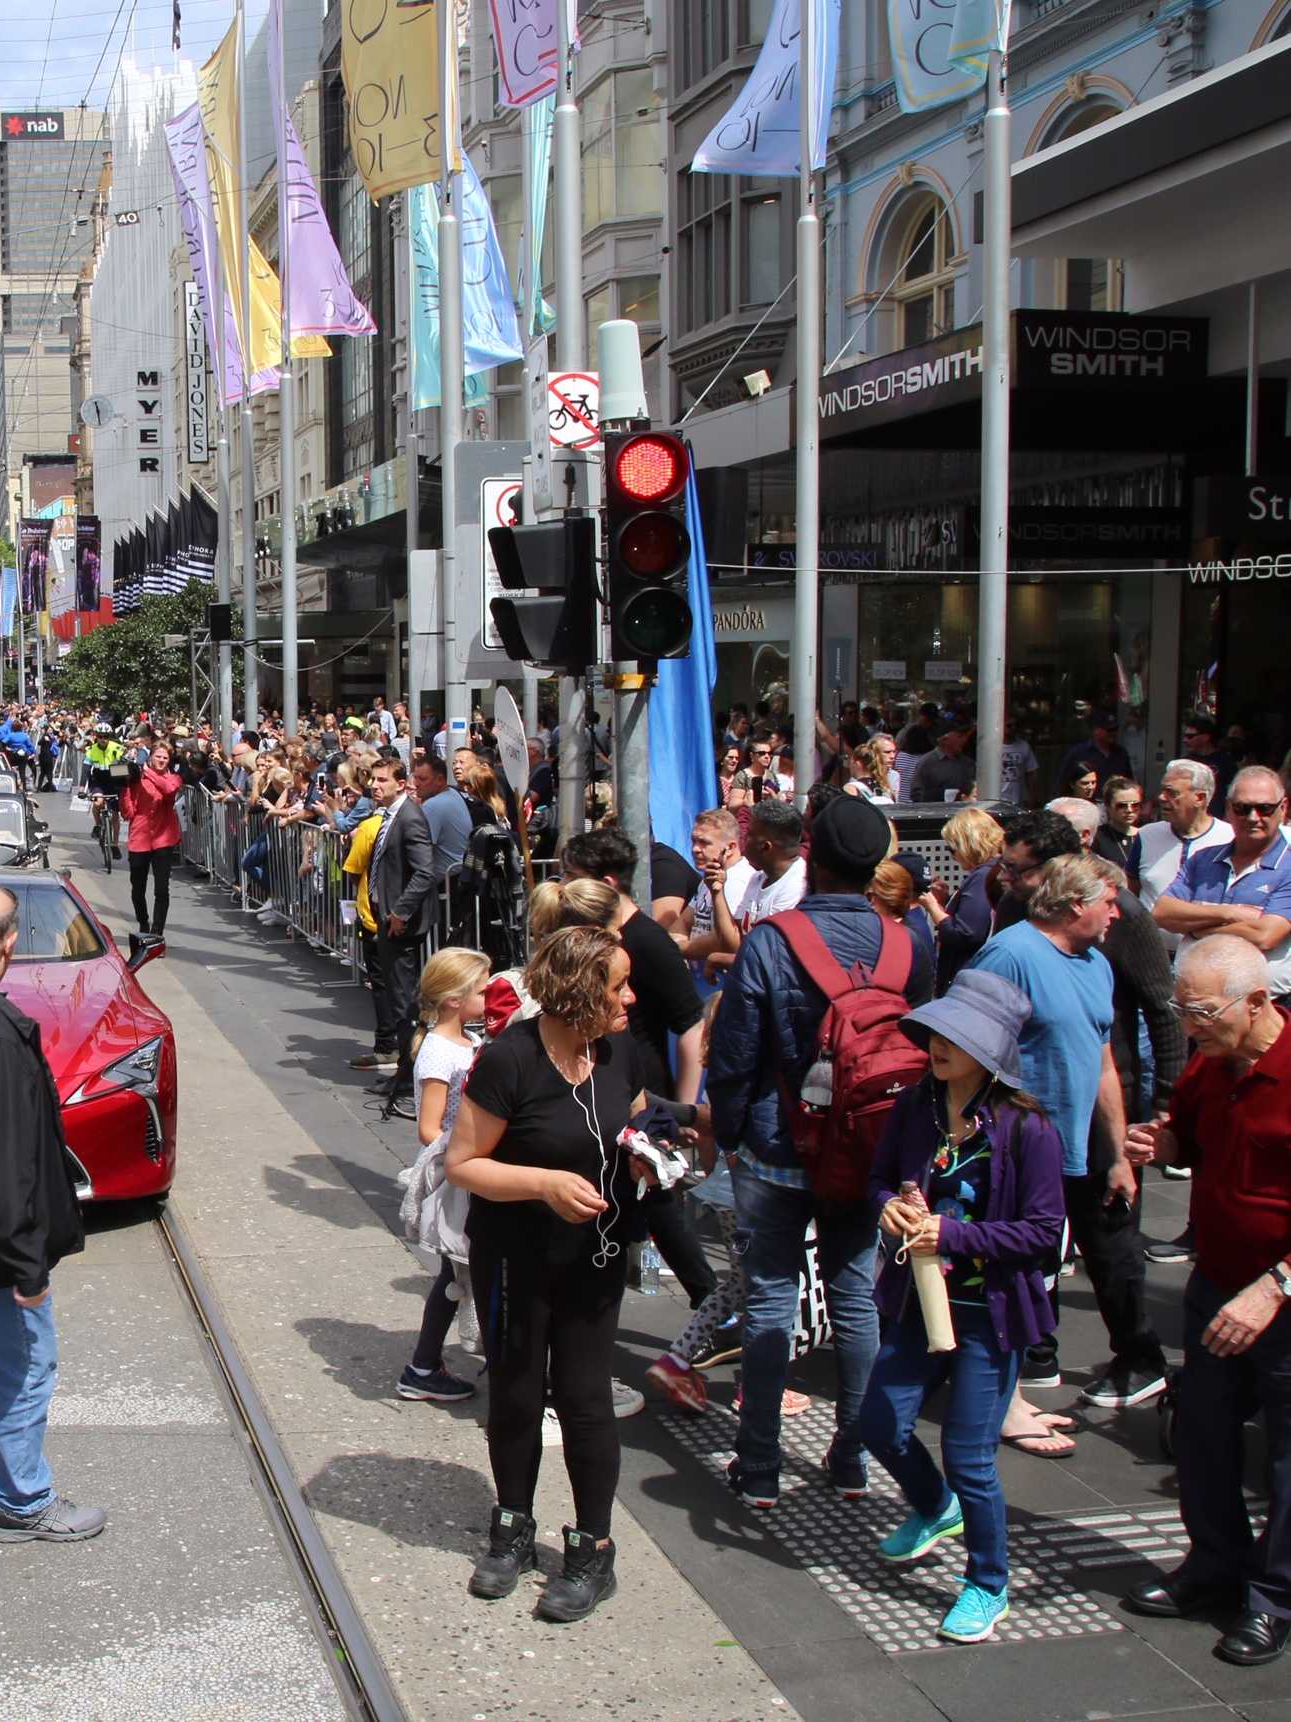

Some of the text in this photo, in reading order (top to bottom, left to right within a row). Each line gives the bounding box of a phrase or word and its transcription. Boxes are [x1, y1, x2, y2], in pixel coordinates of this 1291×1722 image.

[26, 116, 58, 133] nab
[117, 212, 138, 225] 40
[187, 292, 204, 369] DAVID
[1024, 325, 1191, 351] WINDSOR
[1050, 352, 1165, 377] SMITH
[136, 370, 160, 473] MYER
[189, 374, 205, 455] JONES
